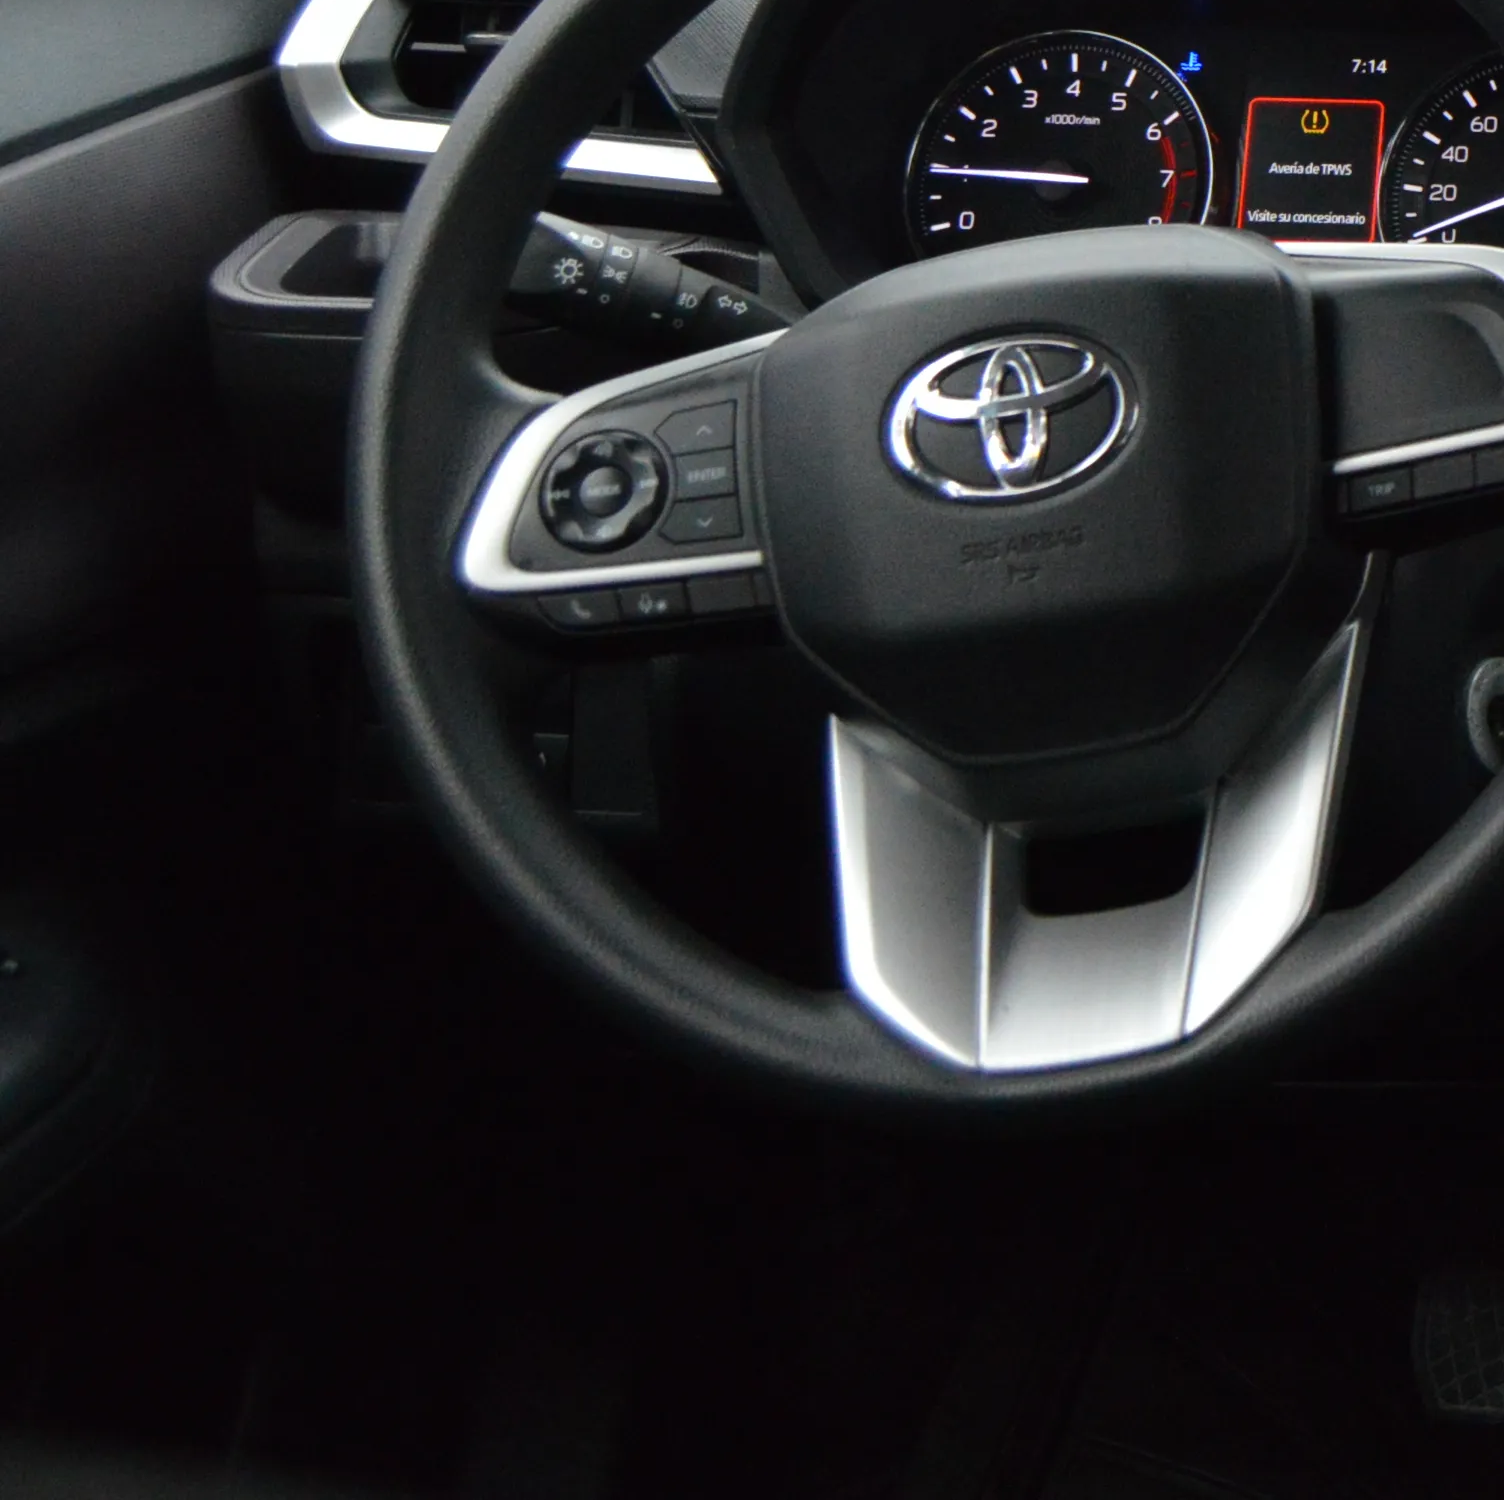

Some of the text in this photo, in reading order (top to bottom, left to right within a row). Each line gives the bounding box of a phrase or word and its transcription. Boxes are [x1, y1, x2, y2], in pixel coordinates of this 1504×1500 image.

[1352, 59, 1387, 74] 7:14
[1066, 79, 1081, 97] 4
[1022, 90, 1038, 108] 3
[1111, 92, 1127, 111] 5
[981, 119, 998, 137] 2
[1045, 114, 1100, 125] x1000r/min
[1470, 116, 1498, 133] 60
[1146, 123, 1161, 141] 6
[1441, 145, 1469, 163] 40
[1268, 161, 1352, 176] Avería de TPWS
[1160, 170, 1175, 188] 7
[1429, 184, 1457, 201] 20
[959, 211, 975, 230] 0
[1248, 210, 1365, 225] Visite su concesionario
